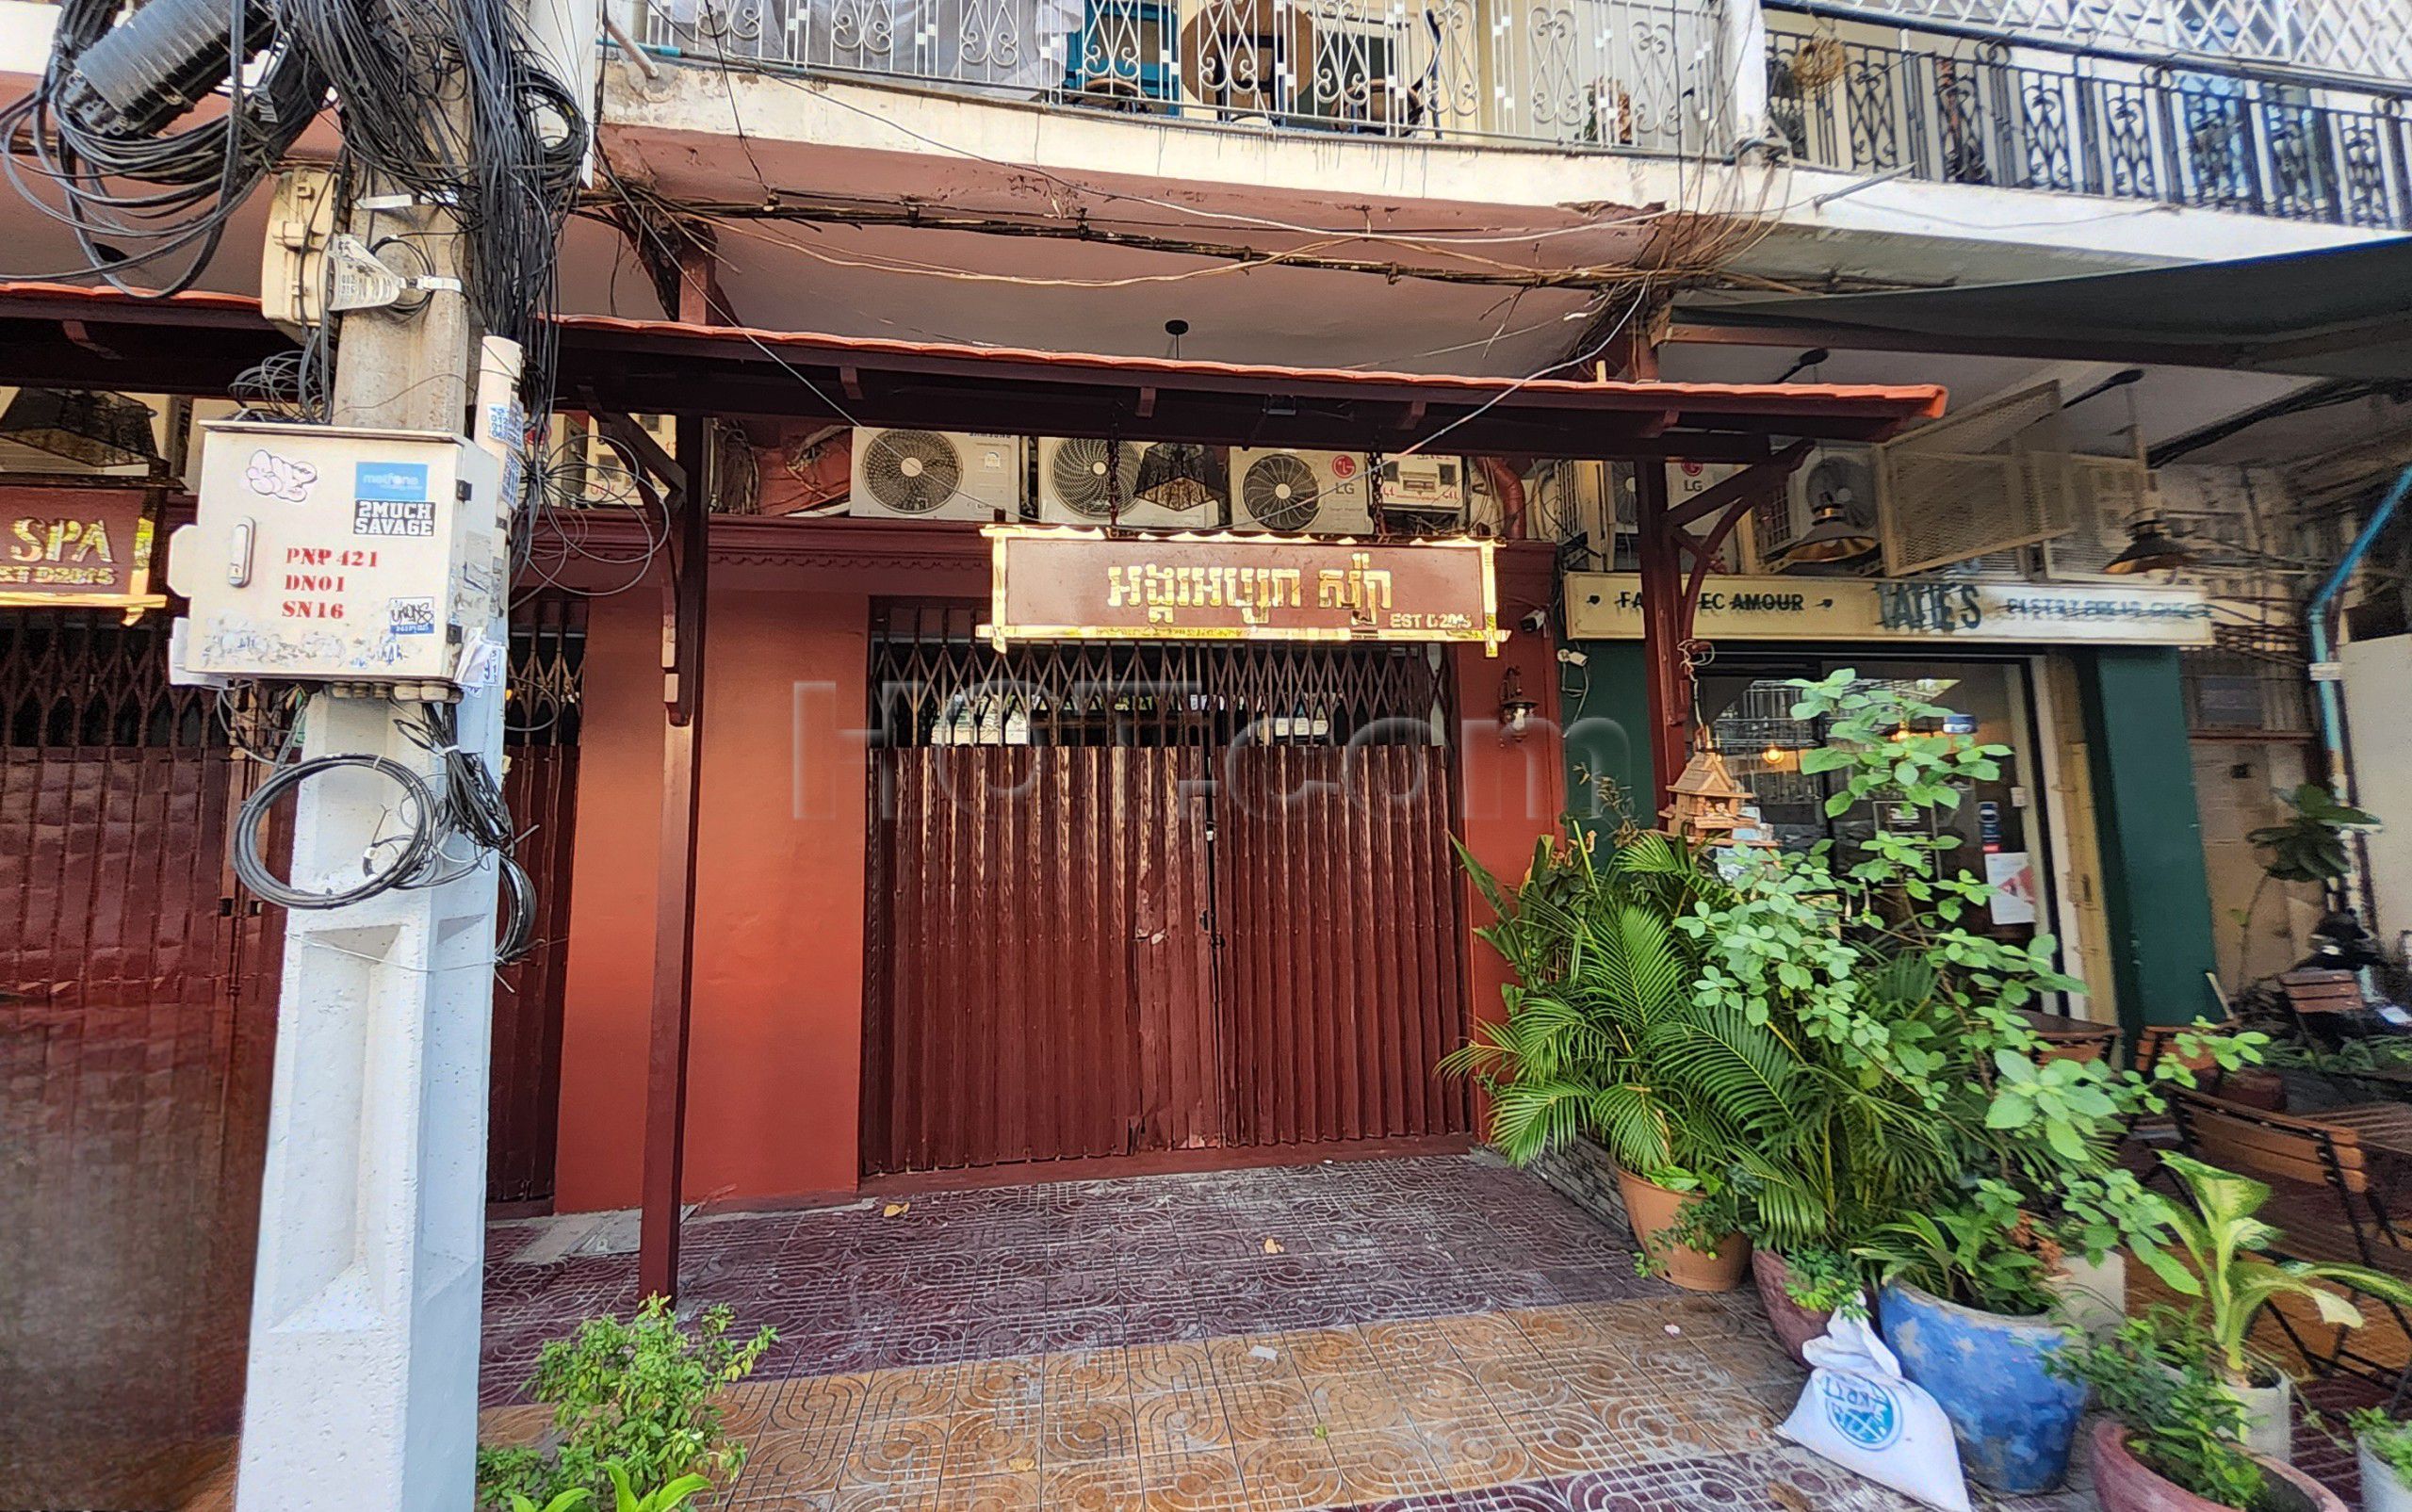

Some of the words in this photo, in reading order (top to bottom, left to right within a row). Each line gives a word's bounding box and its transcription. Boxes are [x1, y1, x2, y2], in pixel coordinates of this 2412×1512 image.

[1336, 482, 1354, 495] LG
[1684, 480, 1703, 492] LG
[359, 500, 432, 519] 2MUCH
[354, 517, 433, 536] SAVAGE
[9, 517, 114, 563] SPA
[285, 547, 332, 566] PNP
[336, 550, 377, 567] 421
[285, 575, 344, 592] DN01
[282, 601, 344, 619] SN16
[1730, 593, 1804, 611] AMOUR
